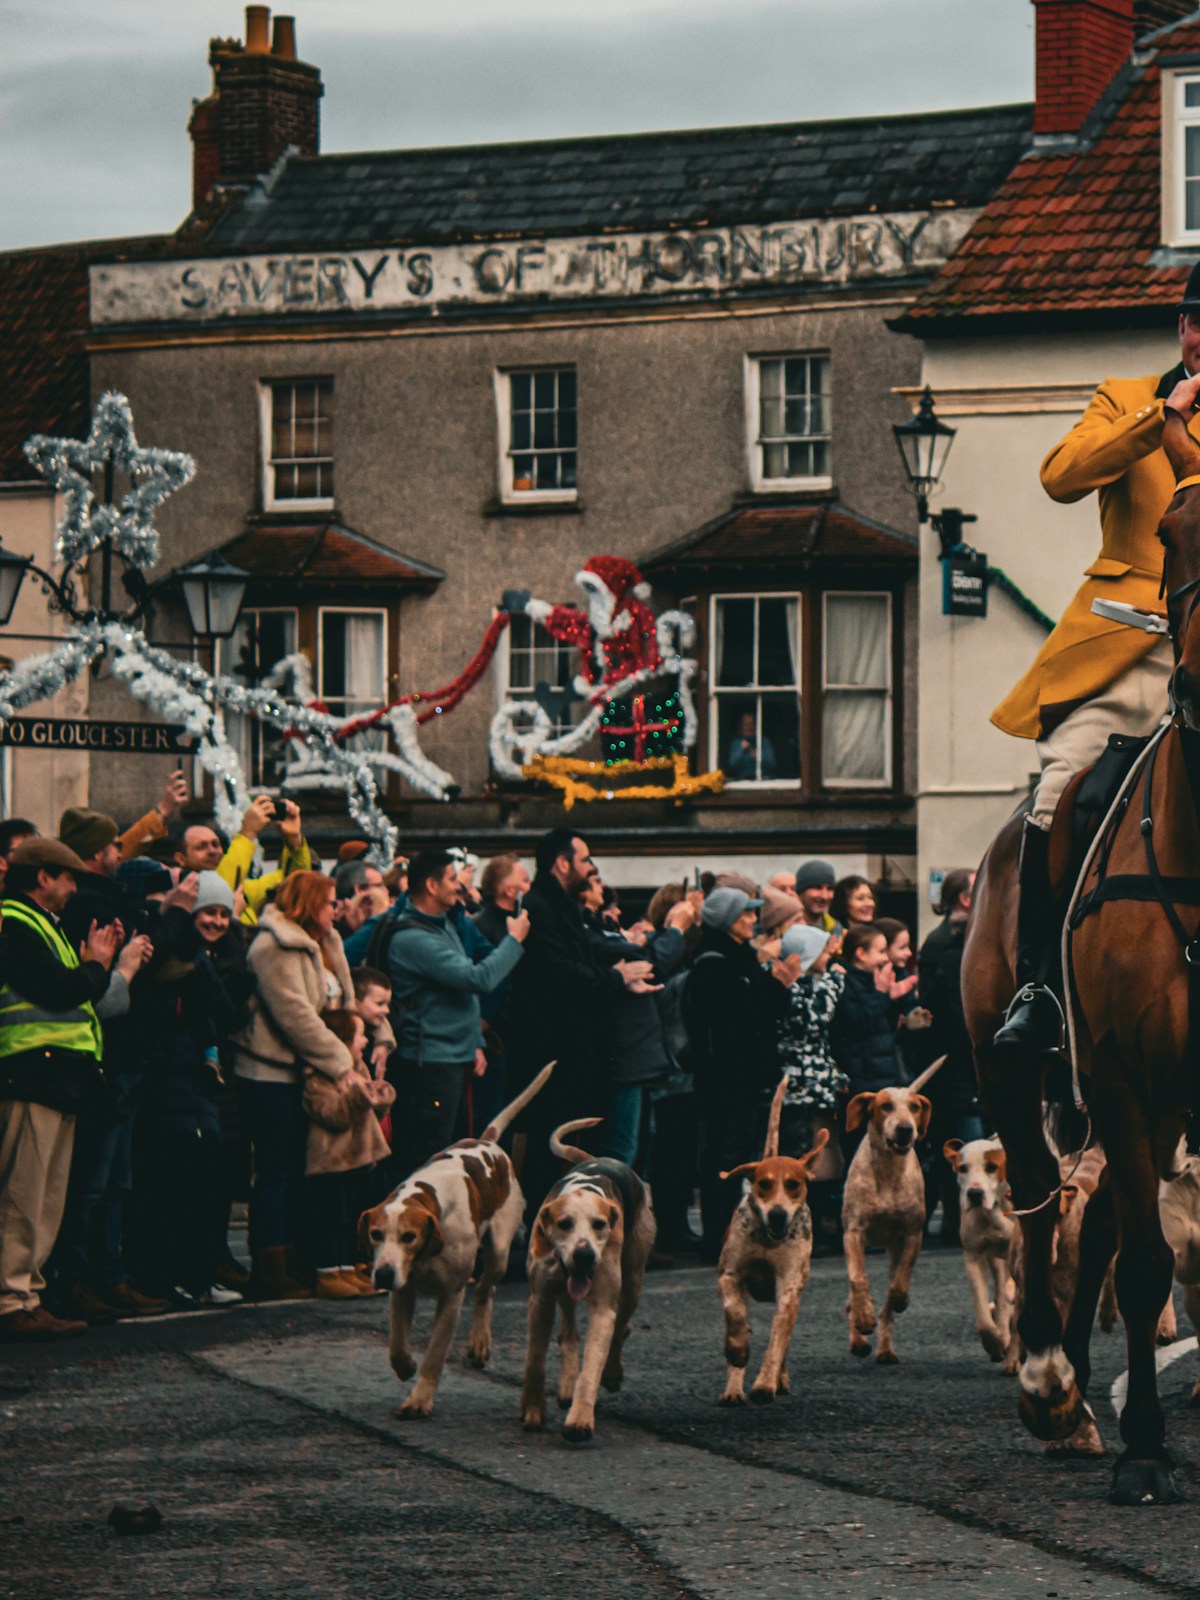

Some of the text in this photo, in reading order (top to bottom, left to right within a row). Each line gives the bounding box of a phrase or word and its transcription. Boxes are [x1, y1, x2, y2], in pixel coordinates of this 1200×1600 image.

[475, 246, 547, 293] OF
[587, 217, 929, 288] THORNBURY
[31, 723, 169, 748] GLOUCESTER
